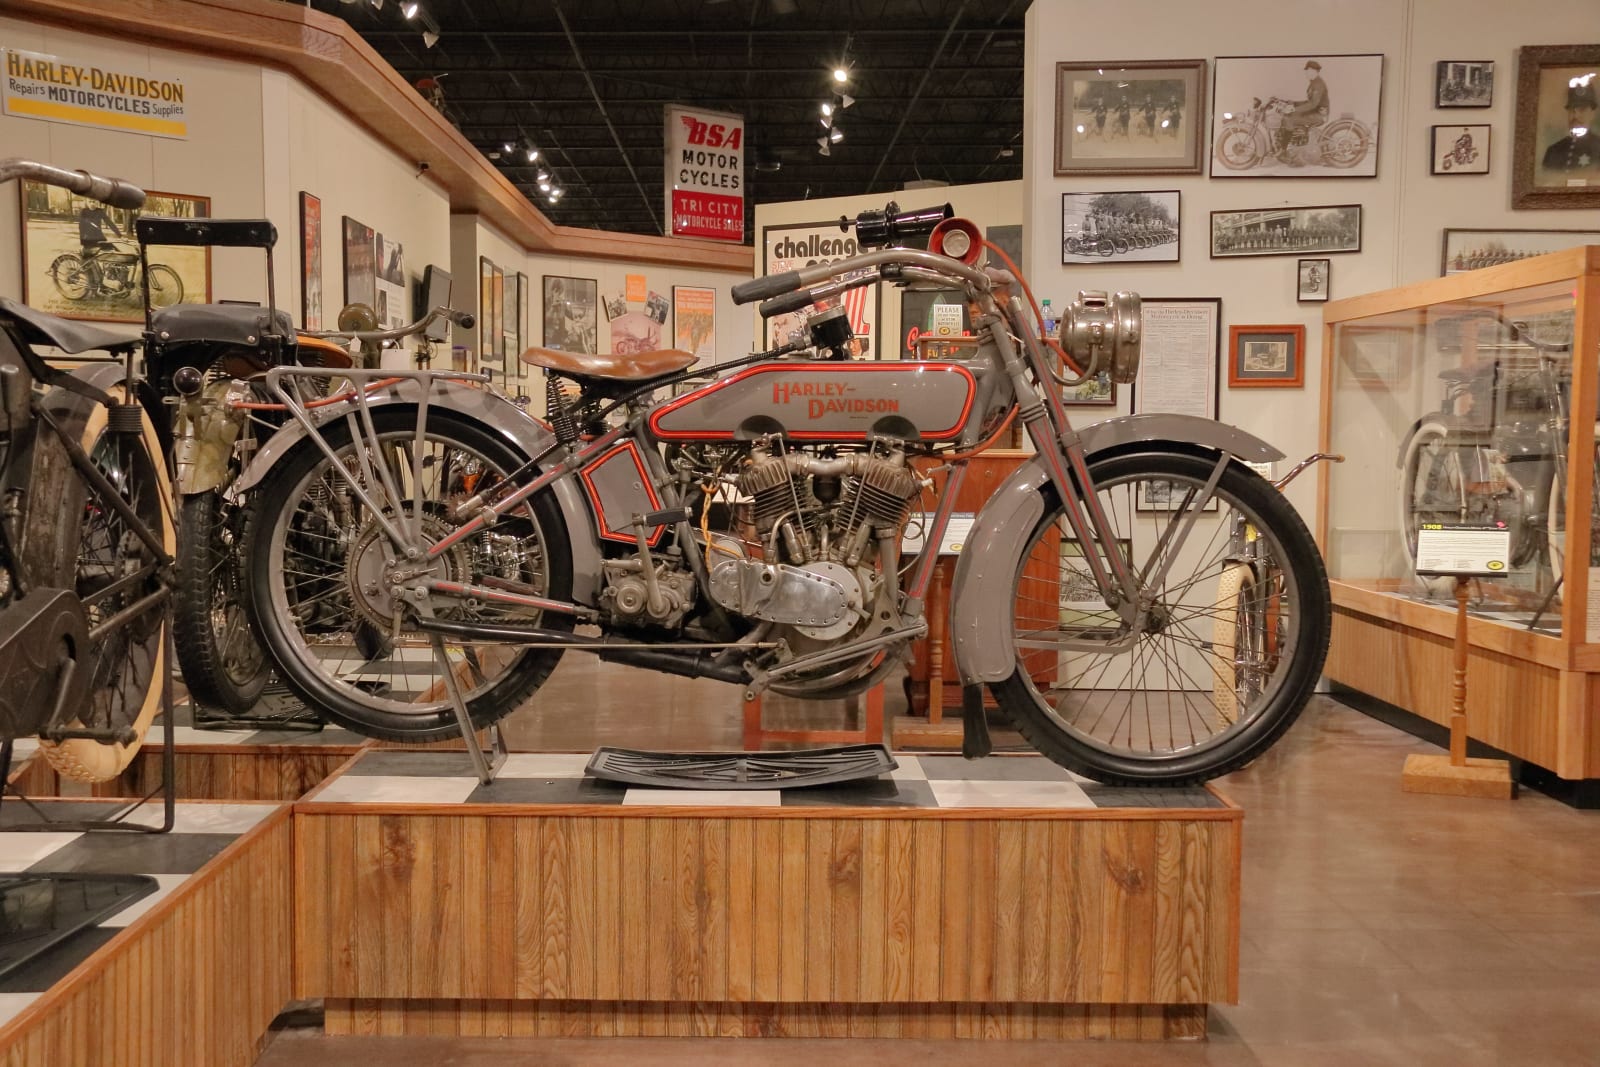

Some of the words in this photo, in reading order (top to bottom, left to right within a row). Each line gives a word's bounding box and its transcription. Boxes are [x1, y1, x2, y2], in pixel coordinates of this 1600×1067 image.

[9, 78, 46, 96] Repairs
[48, 86, 150, 115] MOTORCYCLES
[152, 103, 184, 118] Supplies
[682, 117, 742, 150] BSA
[682, 149, 738, 170] MOTOR
[680, 169, 739, 189] CYCLES
[681, 198, 702, 213] TRI
[708, 201, 738, 216] CITY
[676, 214, 721, 229] MOTORCYCLE
[808, 399, 899, 419] DAVIDSON
